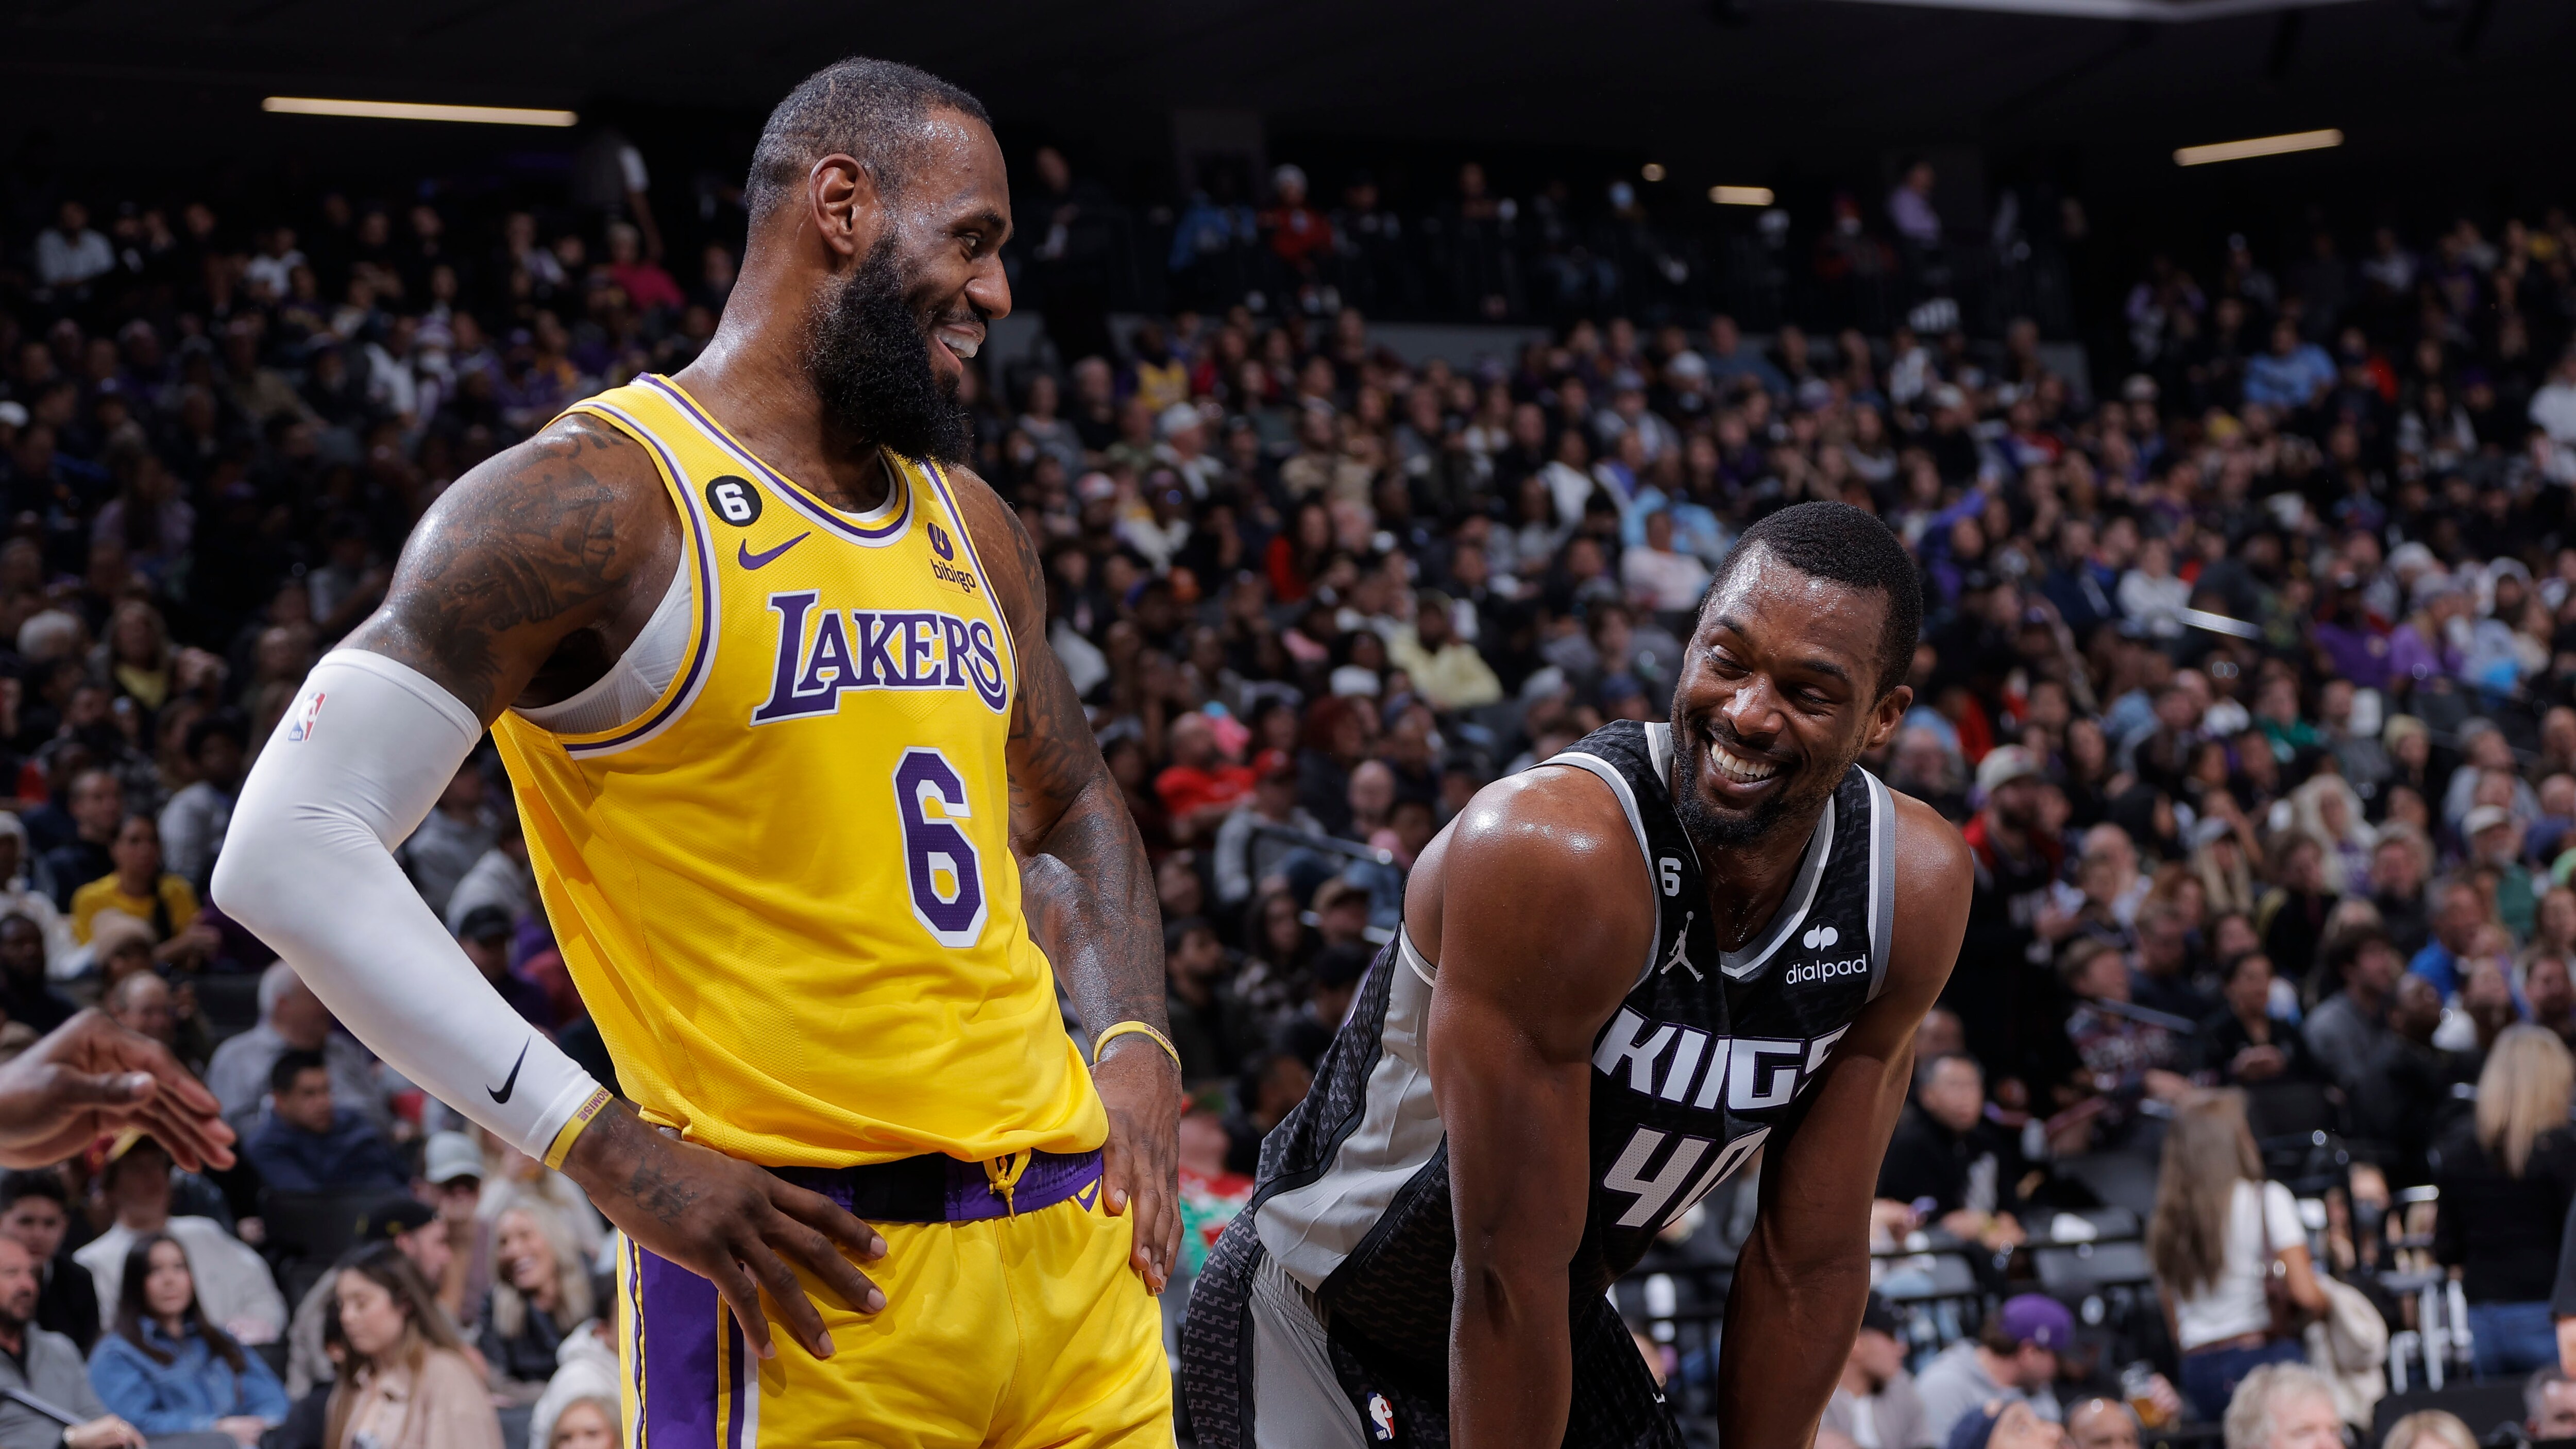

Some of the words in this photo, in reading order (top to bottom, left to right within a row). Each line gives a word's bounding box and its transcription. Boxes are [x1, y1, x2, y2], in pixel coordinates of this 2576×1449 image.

[716, 483, 751, 520] 6
[930, 559, 975, 593] bibigo
[750, 589, 1008, 727] LAKERS
[891, 746, 988, 948] 6
[1659, 857, 1682, 896] 6
[1786, 954, 1867, 985] dialpad
[1376, 1429, 1387, 1441] NBA
